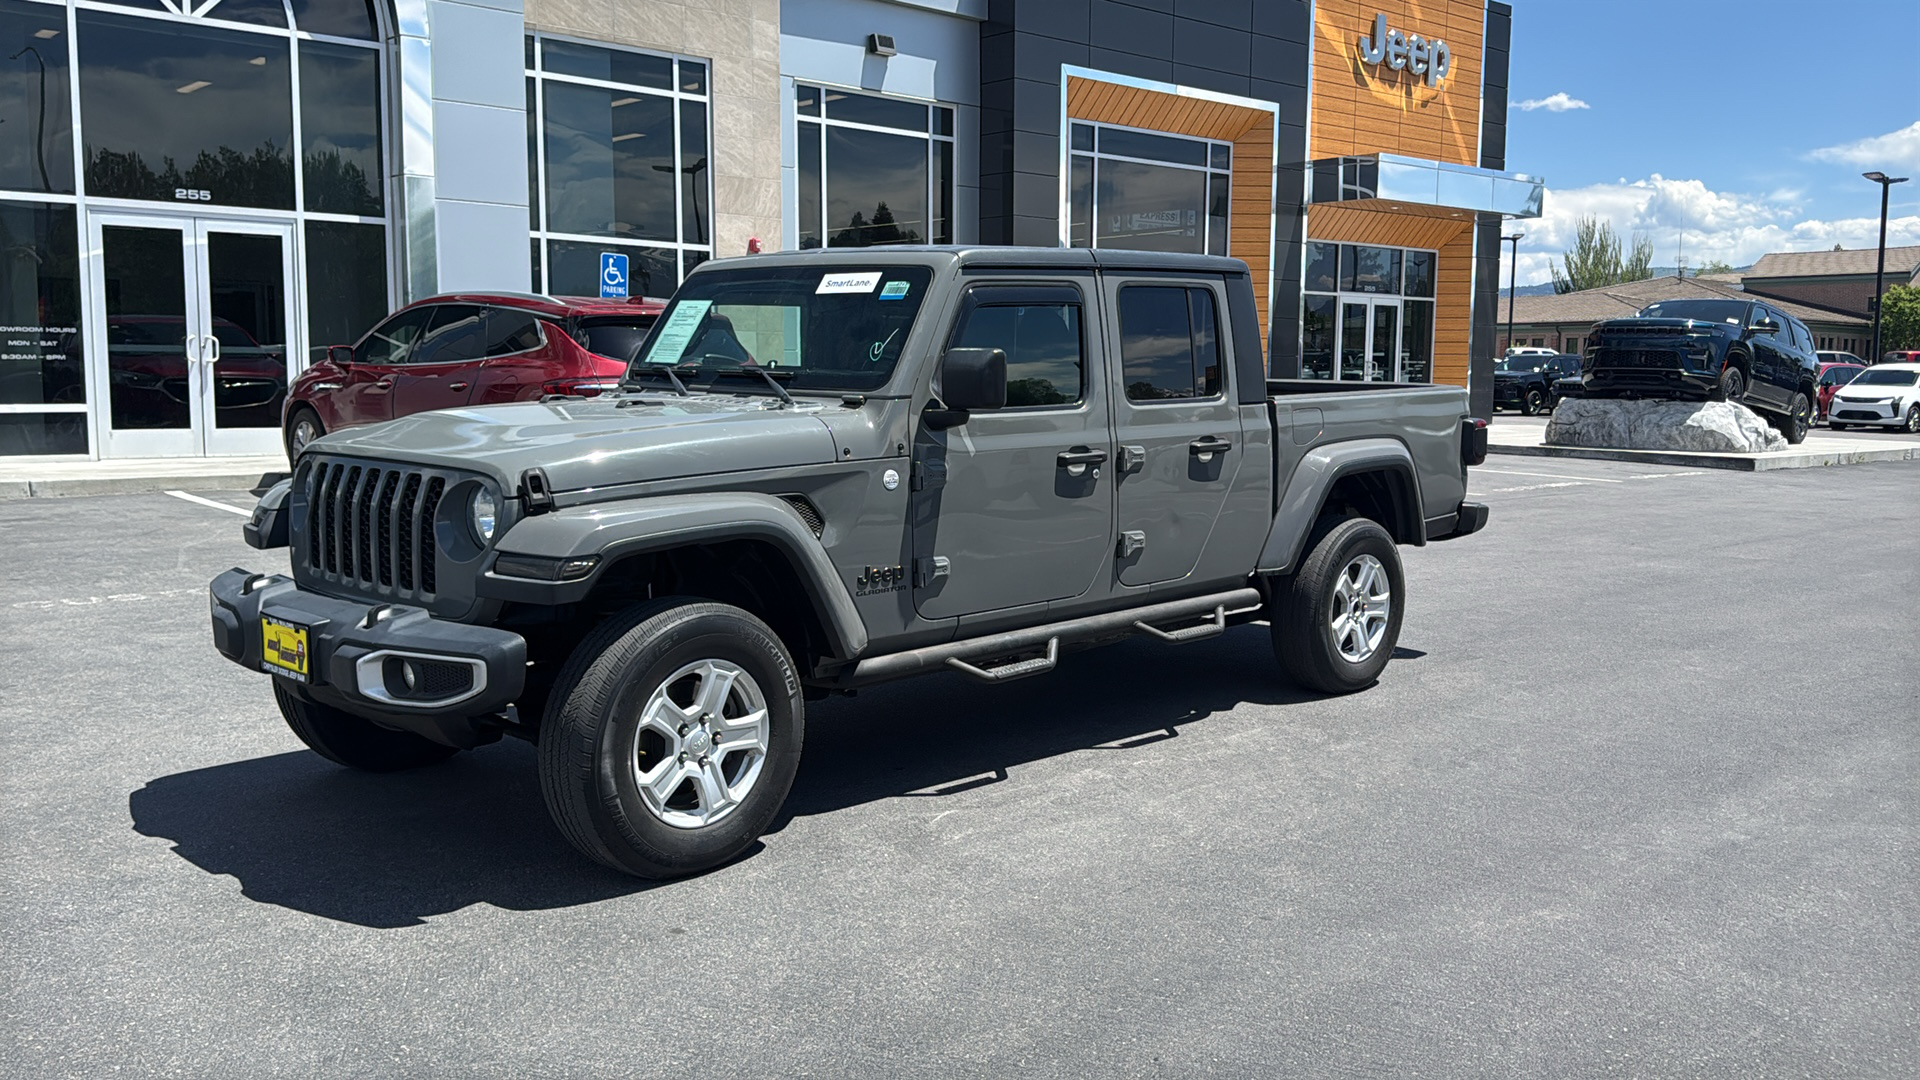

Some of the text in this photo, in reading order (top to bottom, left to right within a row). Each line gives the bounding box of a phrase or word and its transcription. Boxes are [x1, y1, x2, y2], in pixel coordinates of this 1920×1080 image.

[1359, 13, 1450, 88] Jeep
[175, 188, 212, 201] 255
[602, 285, 626, 295] PARKING
[825, 279, 869, 288] SmartLane
[857, 565, 904, 585] Jeep
[855, 584, 907, 597] GLADIATOR
[754, 633, 797, 697] MICHELIN
